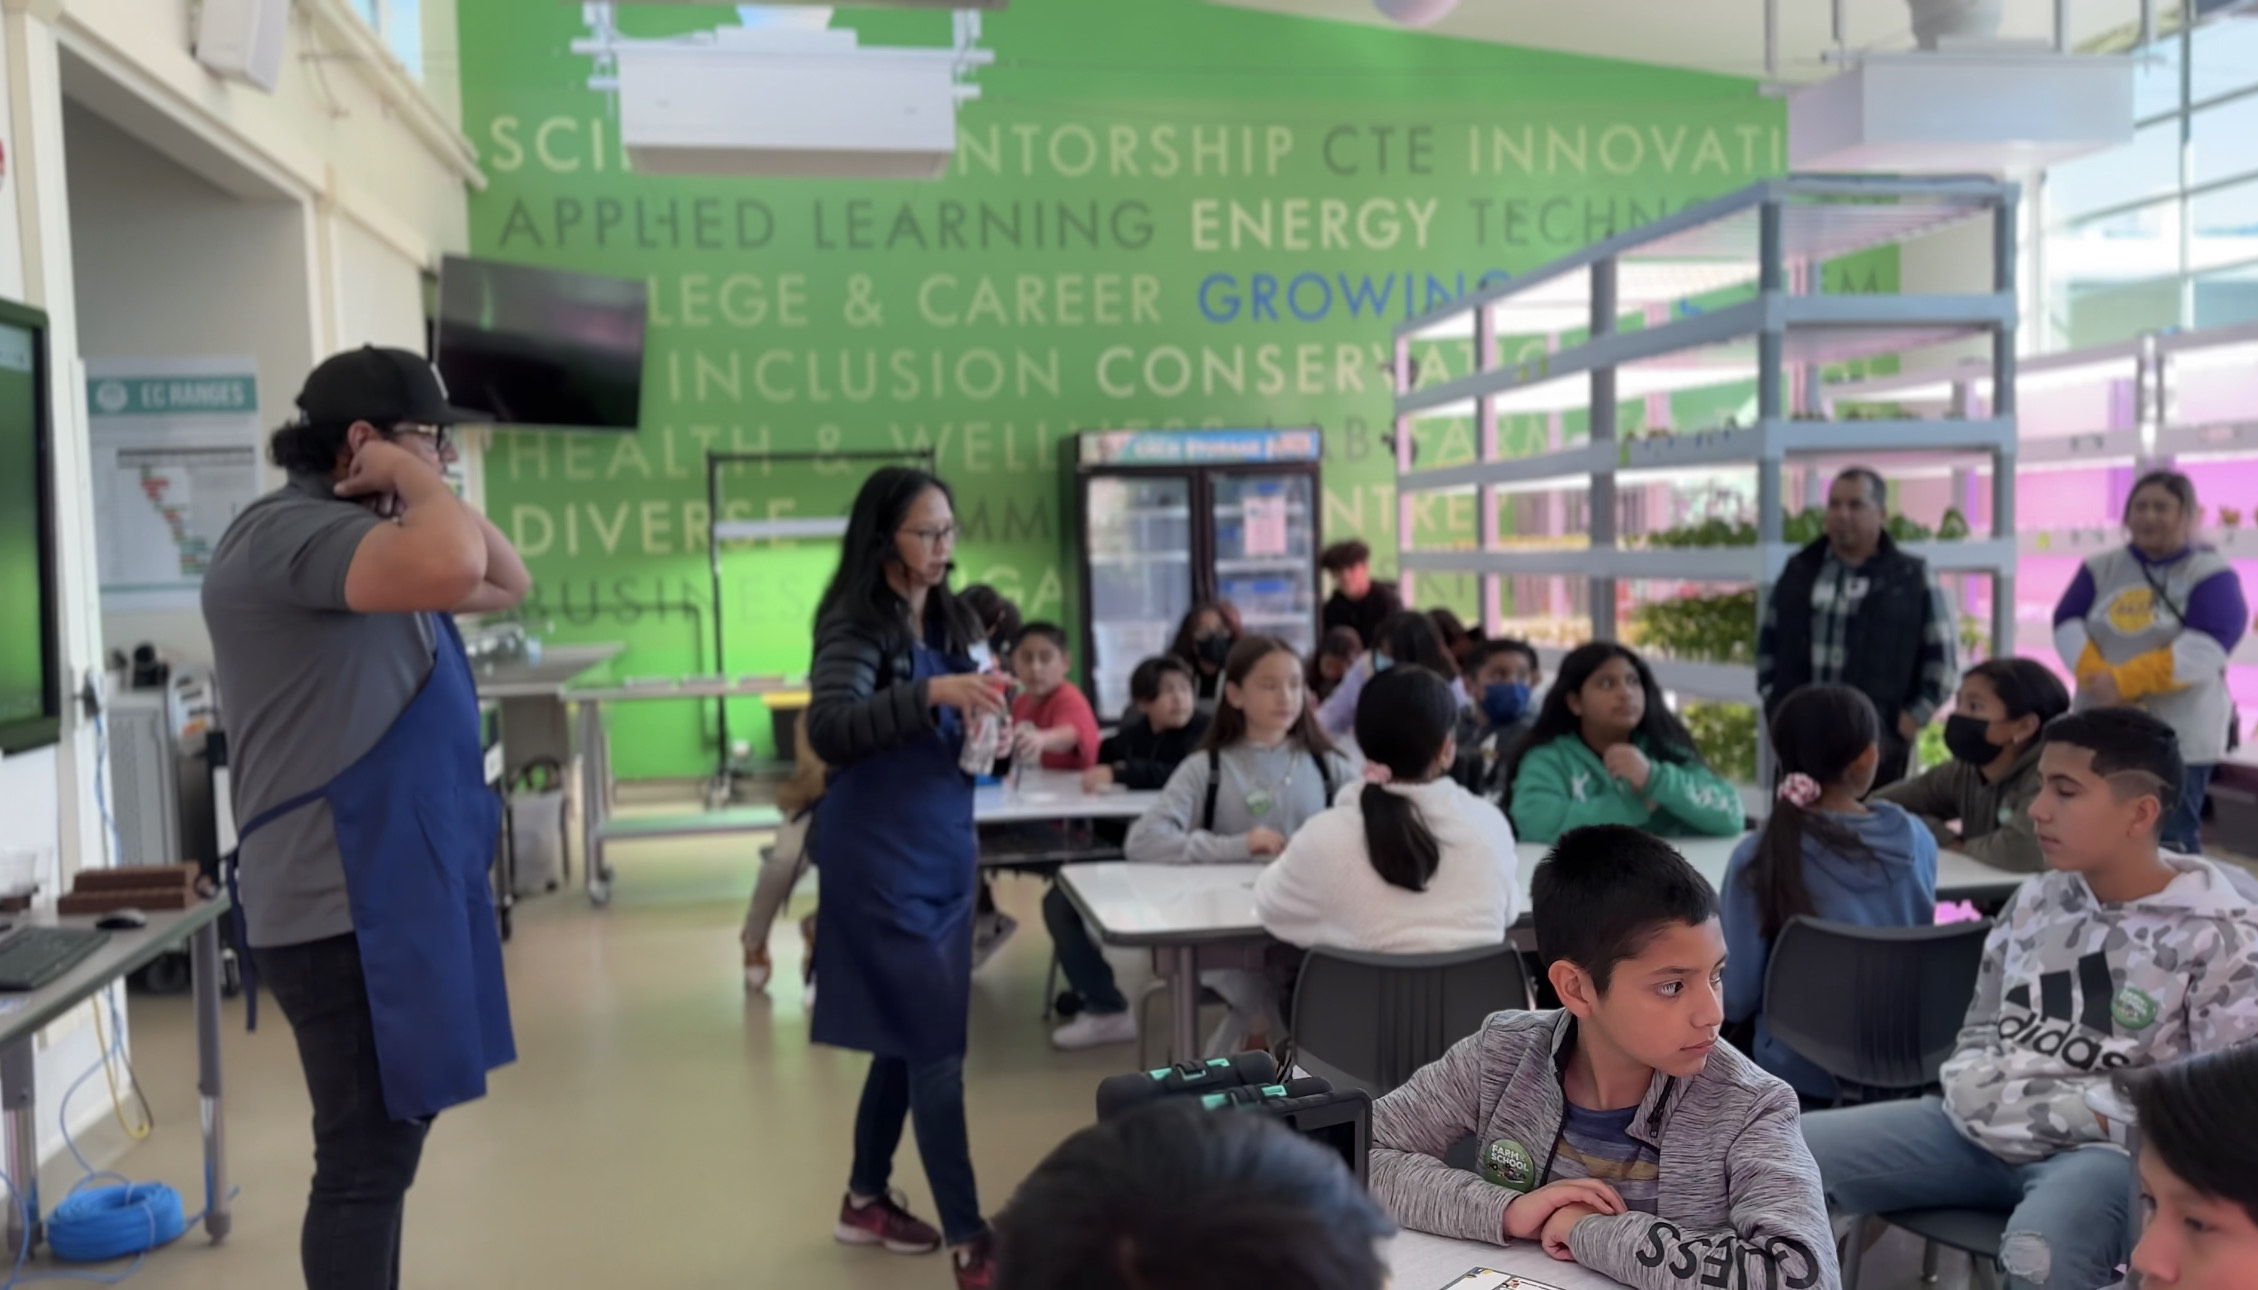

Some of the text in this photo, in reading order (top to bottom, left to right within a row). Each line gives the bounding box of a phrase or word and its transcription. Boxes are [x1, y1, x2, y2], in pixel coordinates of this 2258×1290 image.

[957, 122, 1294, 178] NTORSHIP
[1322, 124, 1434, 177] CTE
[1469, 124, 1781, 175] INNOVATI
[498, 195, 776, 249] APPLIED
[813, 197, 1157, 251] LEARNING
[1190, 197, 1438, 252] ENERGY
[648, 274, 808, 328] LEGE
[843, 273, 884, 328] &
[918, 273, 1162, 327] CAREER
[667, 348, 1064, 404] INCLUSION
[508, 424, 770, 481] HEALTH
[511, 496, 798, 558] DIVERSE
[1490, 1152, 1530, 1173] SCHOOL
[1491, 1144, 1519, 1161] FARM
[1635, 1221, 1820, 1290] GUESS
